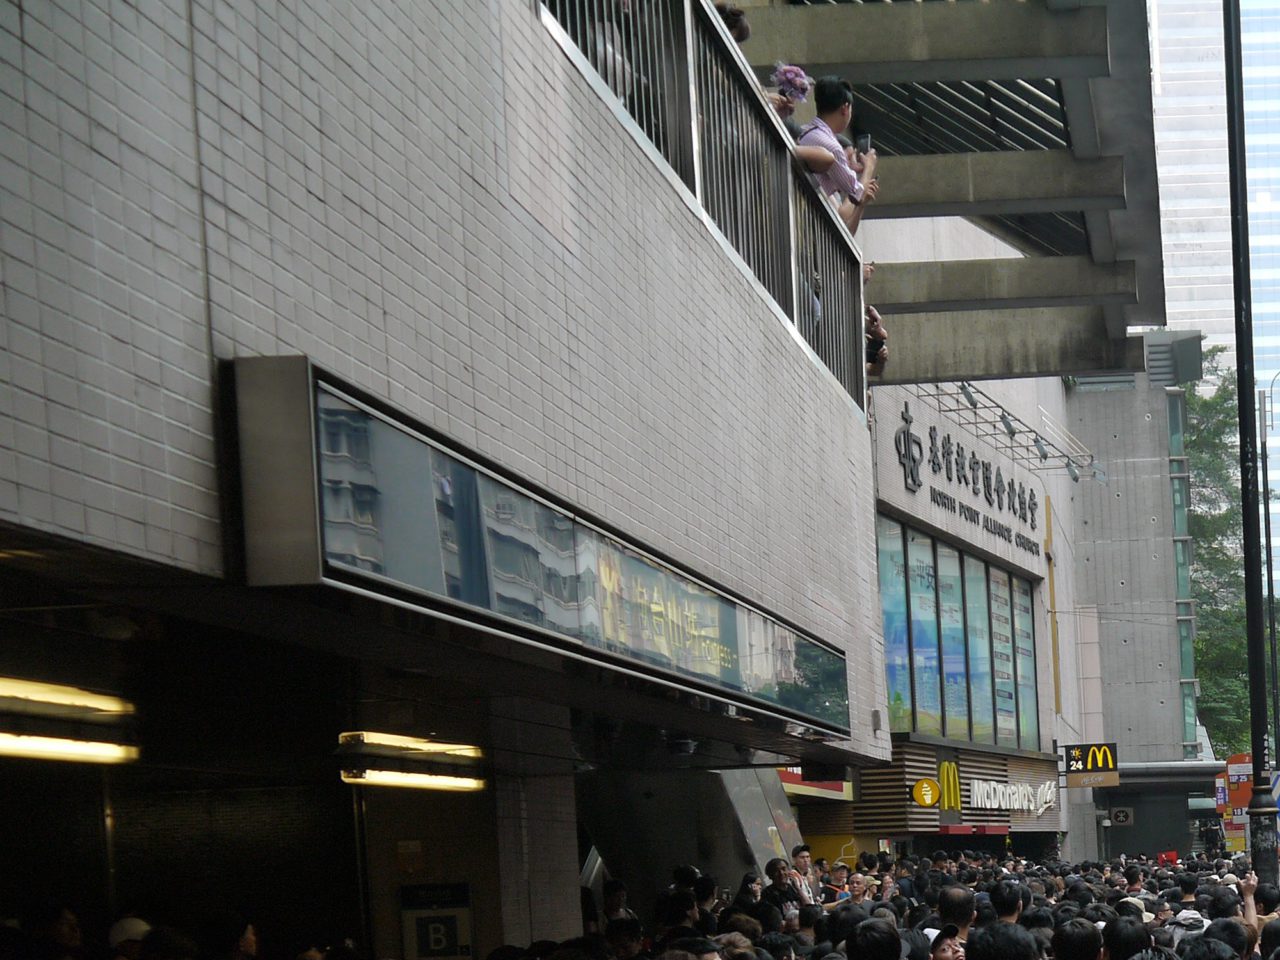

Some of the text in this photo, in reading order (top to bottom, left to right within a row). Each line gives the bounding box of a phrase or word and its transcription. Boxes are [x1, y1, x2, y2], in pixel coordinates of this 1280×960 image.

[930, 485, 1040, 557] NORTH POINT ALLIANCE CHURCH
[1070, 760, 1084, 770] 24
[970, 779, 1035, 811] McDonald's
[427, 922, 447, 950] B
